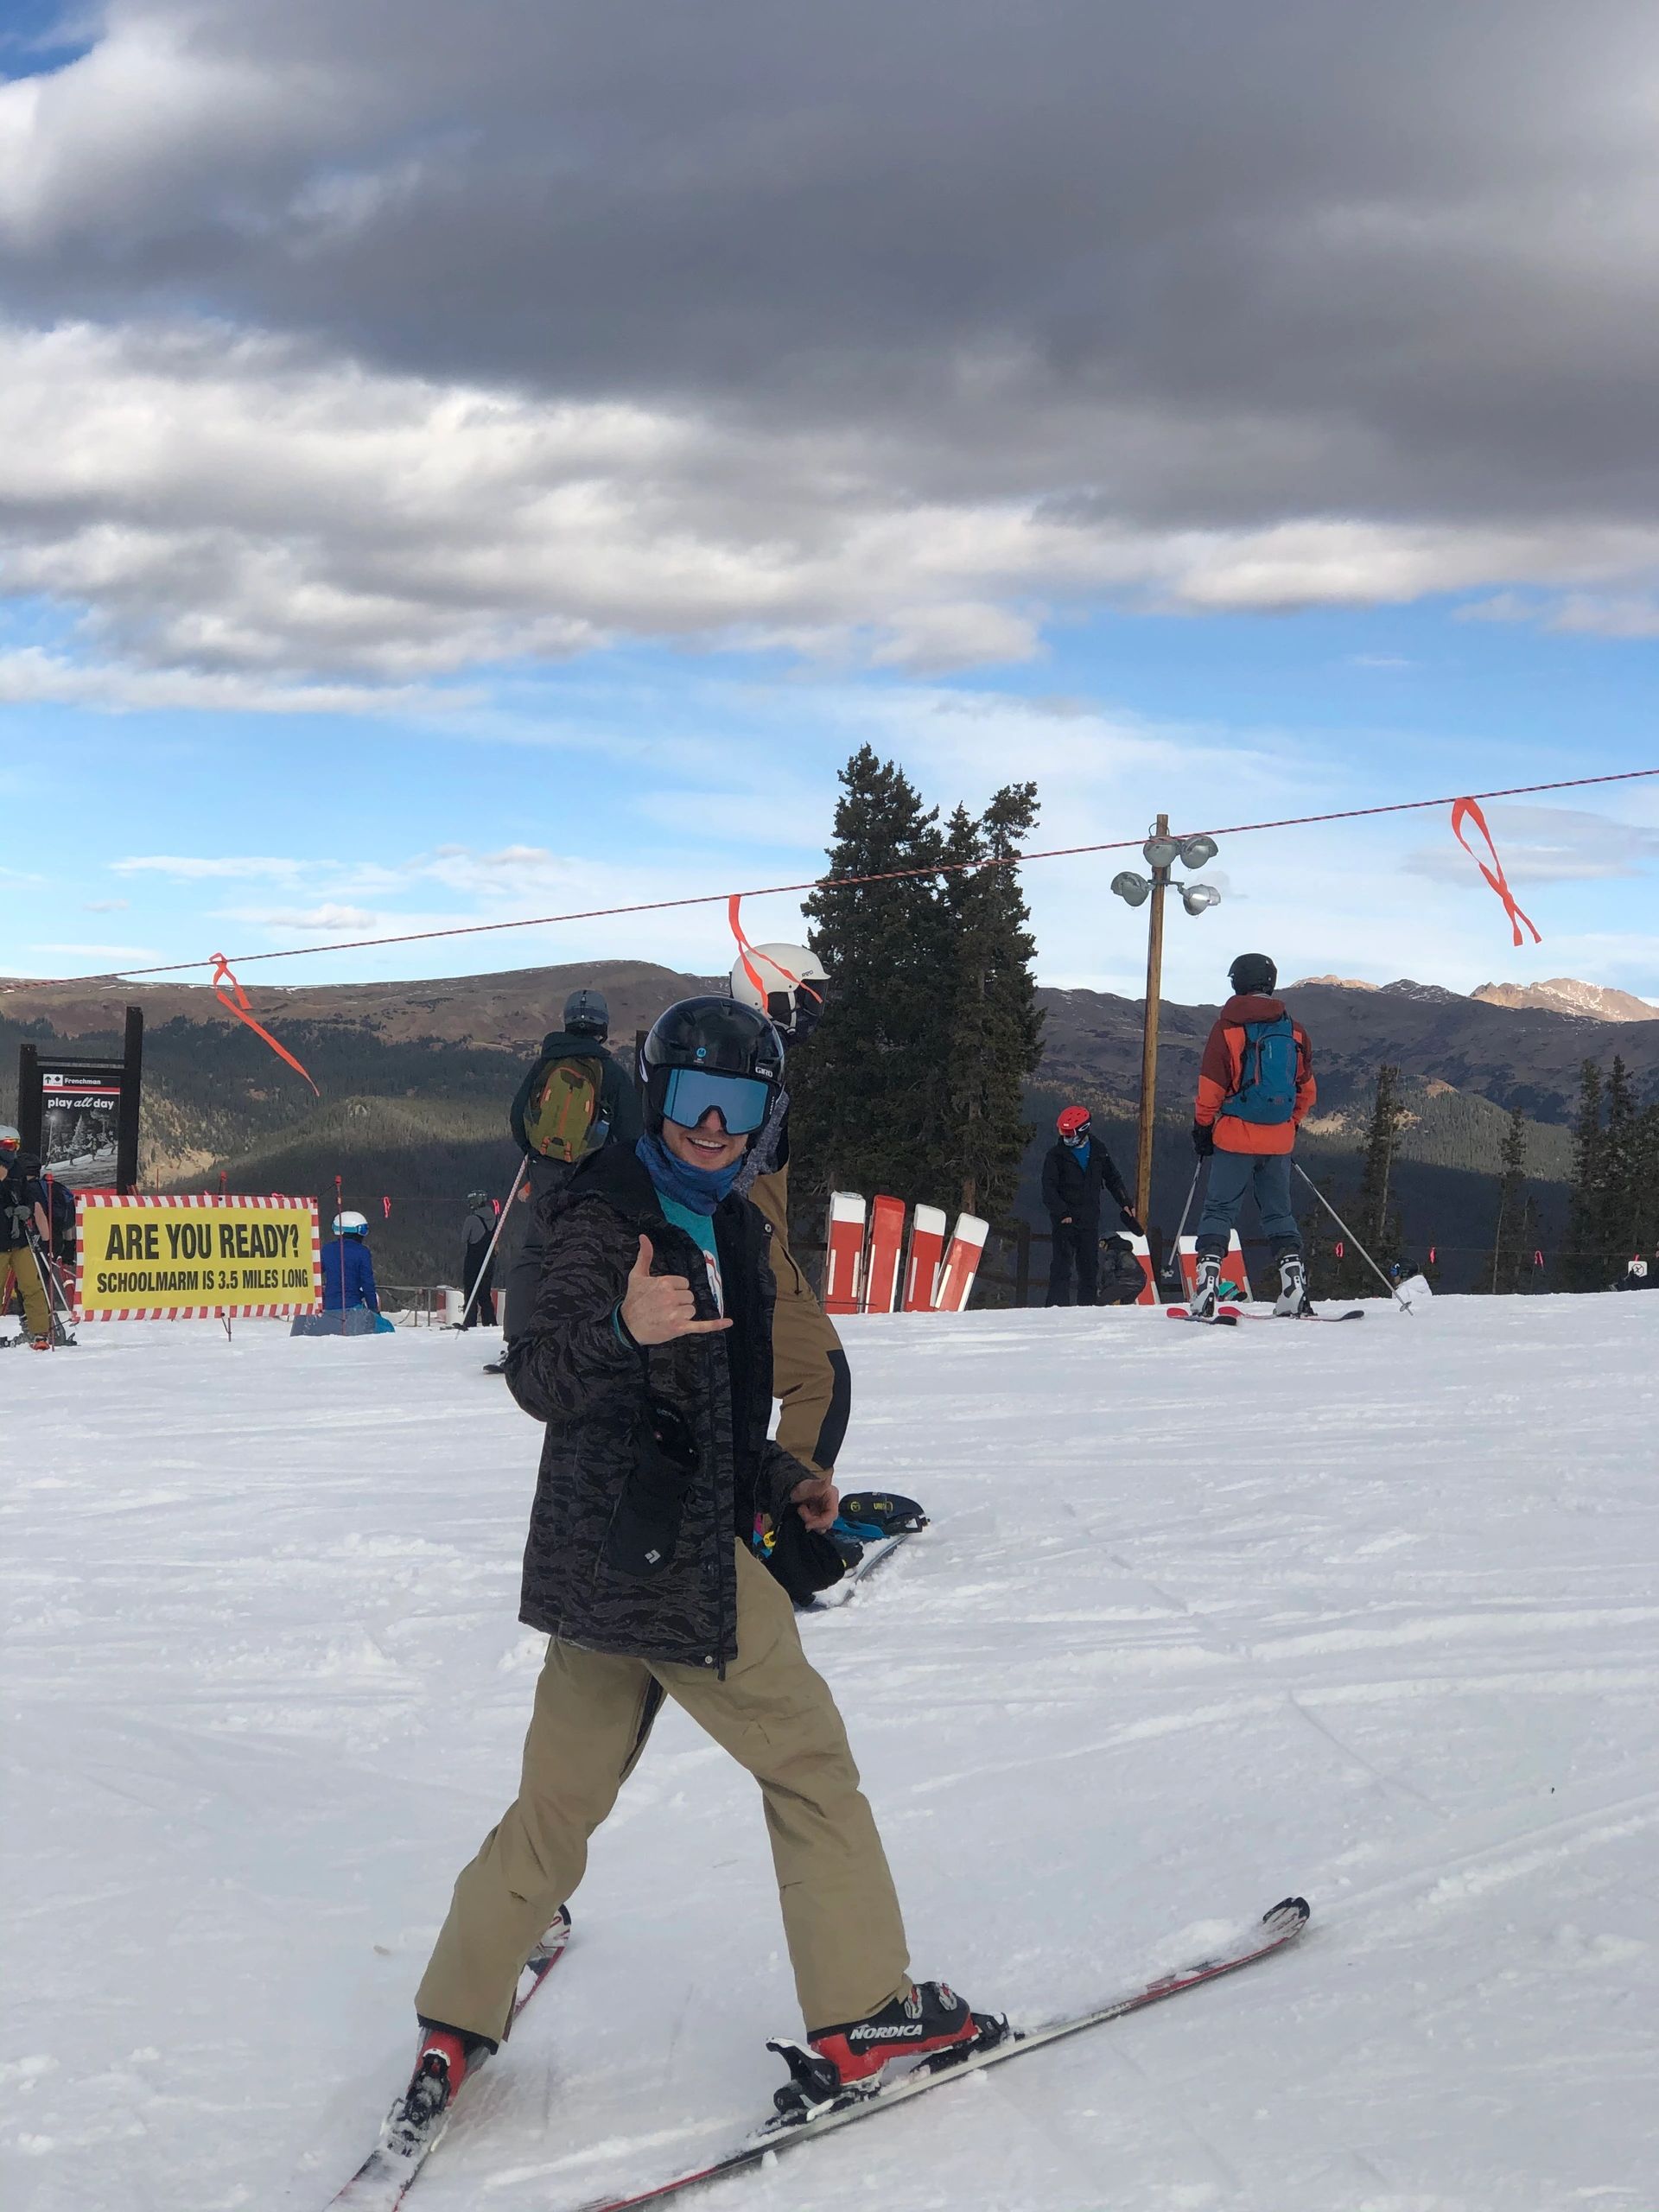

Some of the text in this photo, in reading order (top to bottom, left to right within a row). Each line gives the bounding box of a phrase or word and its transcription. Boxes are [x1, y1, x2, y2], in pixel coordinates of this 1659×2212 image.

[755, 1066, 773, 1077] GIRO
[48, 1096, 114, 1109] play all day
[105, 1224, 299, 1260] ARE YOU READY?
[97, 1268, 308, 1293] SCHOOLMARM IS 3.5 MILES LONG
[849, 2024, 923, 2040] NORDICA
